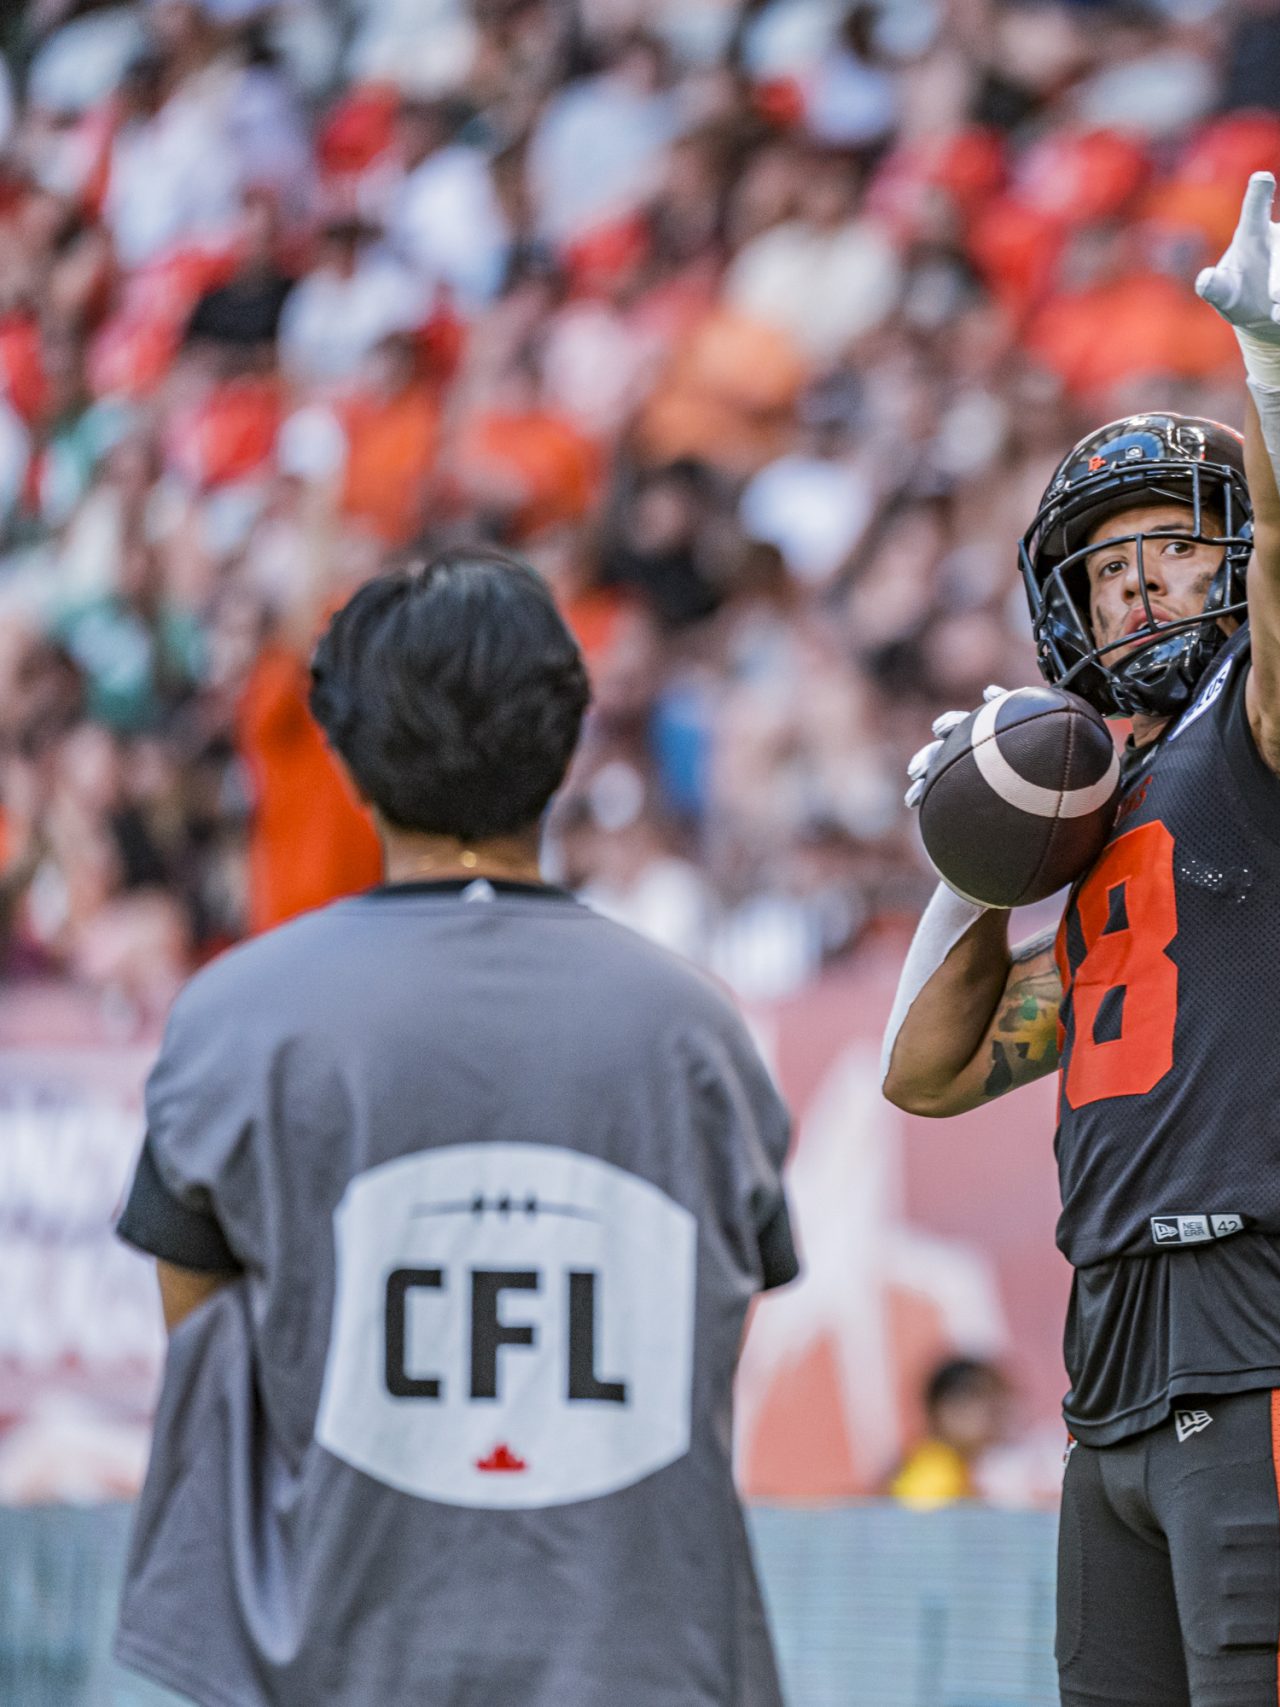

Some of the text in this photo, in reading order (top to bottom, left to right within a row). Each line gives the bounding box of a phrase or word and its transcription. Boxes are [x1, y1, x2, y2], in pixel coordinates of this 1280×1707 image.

[1055, 819, 1178, 1110] 8
[1217, 1220, 1239, 1232] 42
[385, 1268, 626, 1402] CFL
